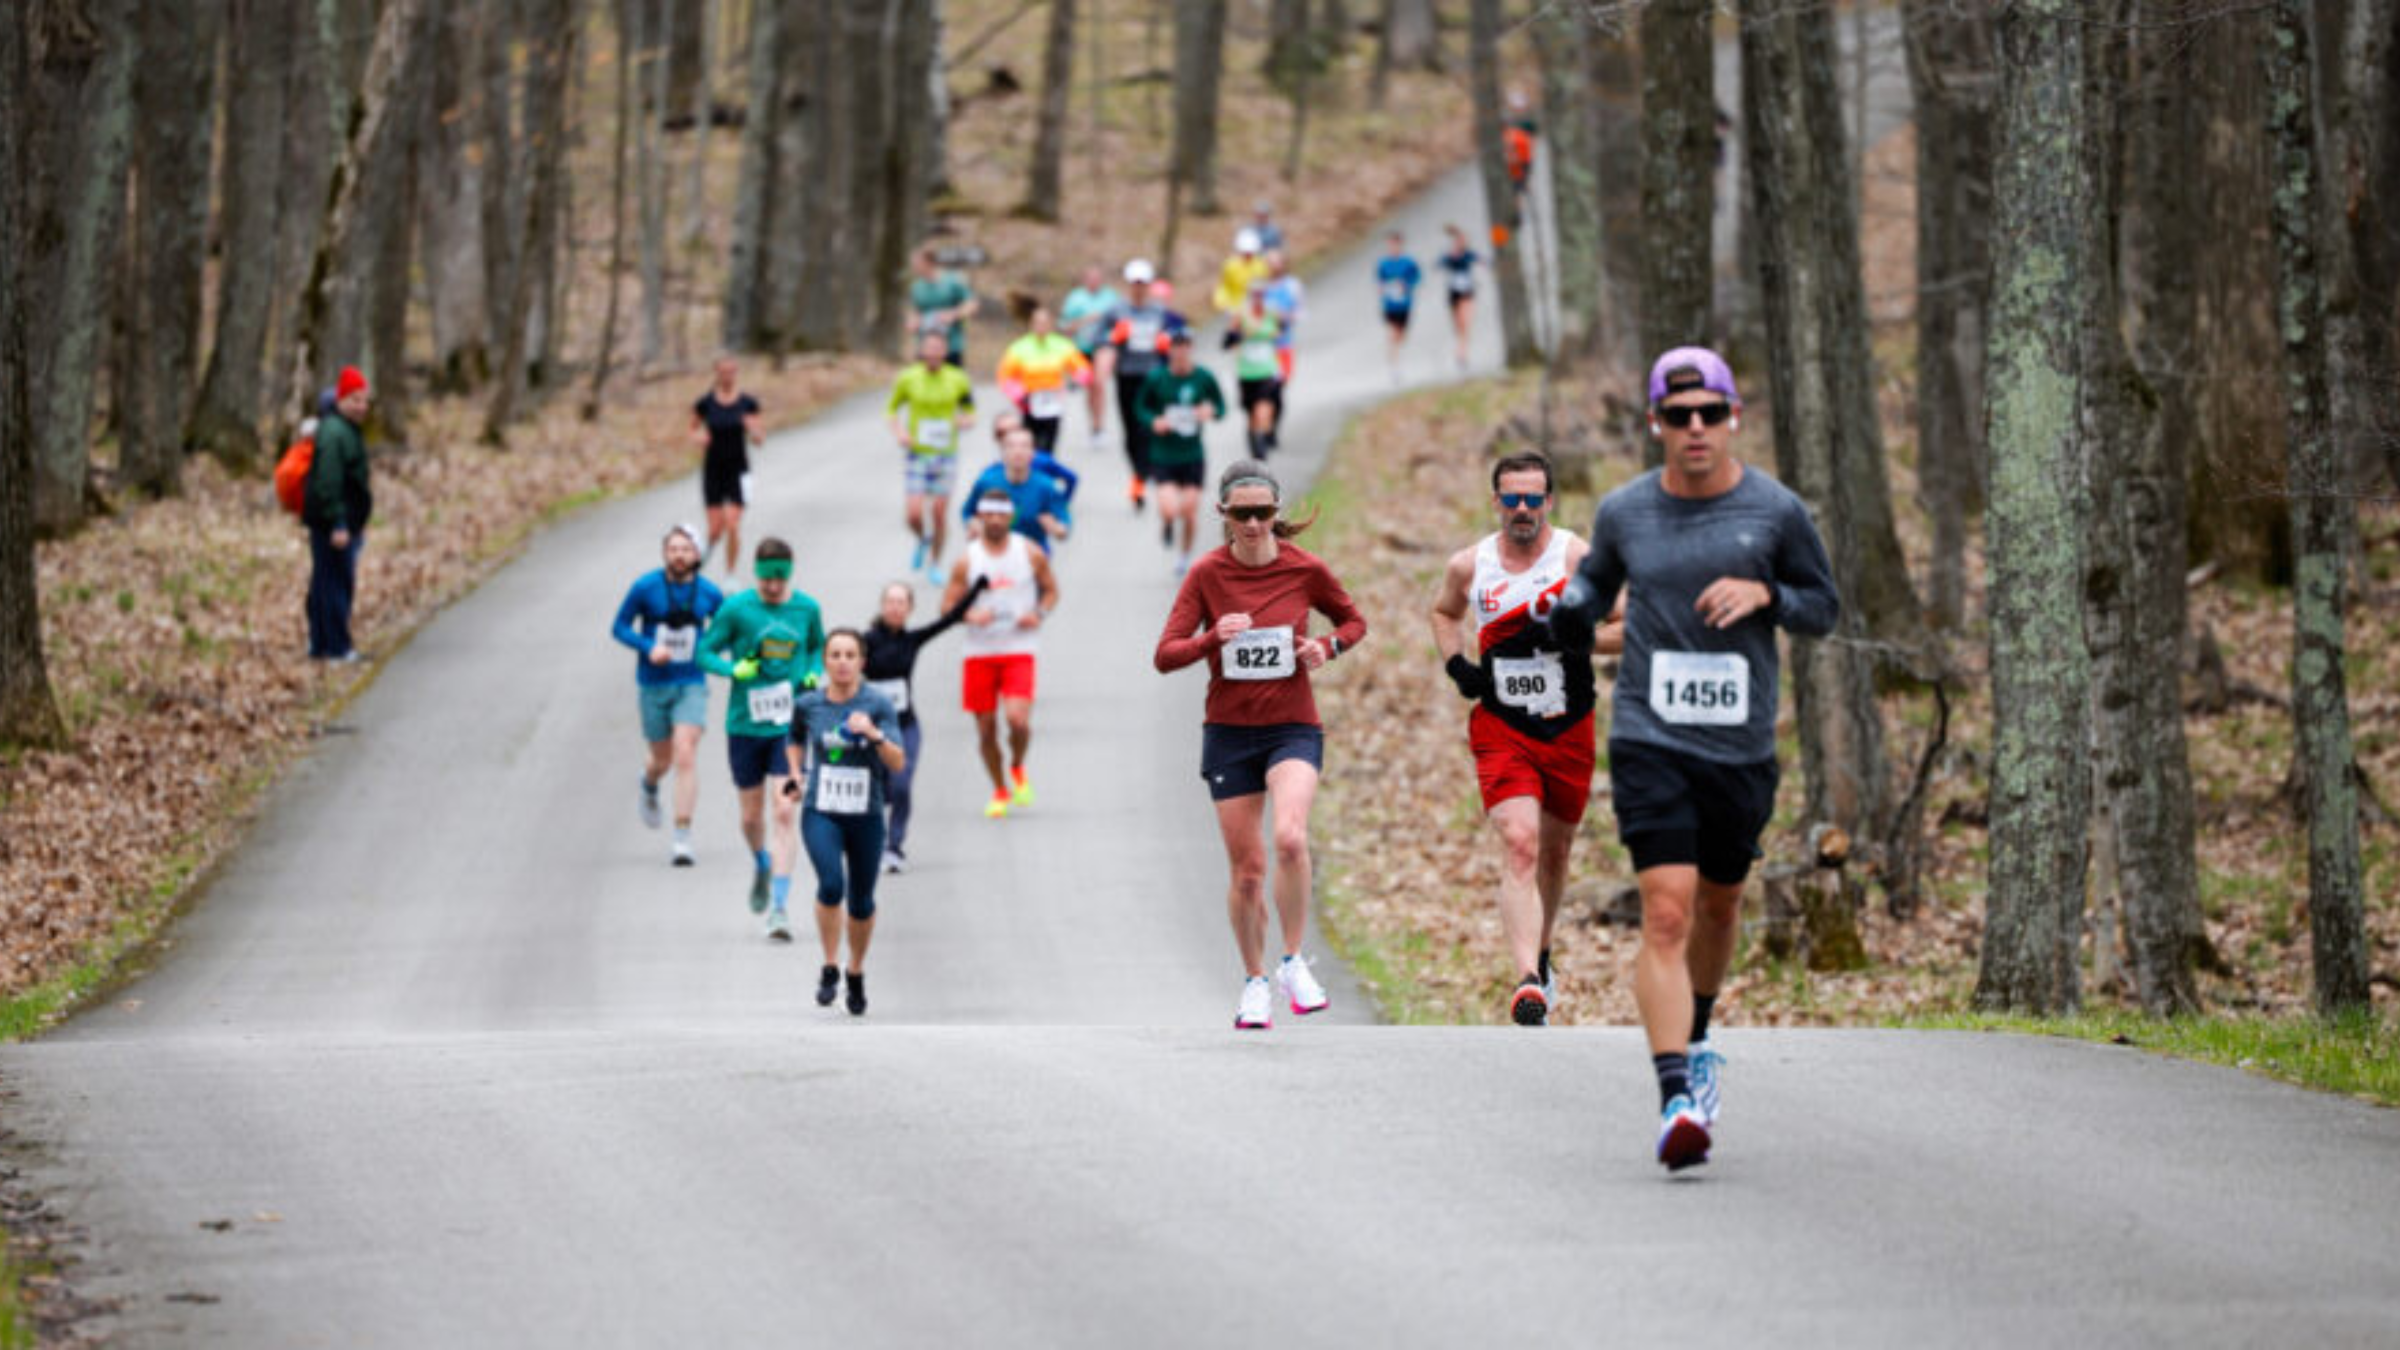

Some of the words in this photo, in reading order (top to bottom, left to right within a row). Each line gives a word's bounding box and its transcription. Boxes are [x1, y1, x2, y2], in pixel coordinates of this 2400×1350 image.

[1237, 646, 1280, 668] 822
[1506, 675, 1546, 696] 890
[1663, 679, 1738, 708] 1456
